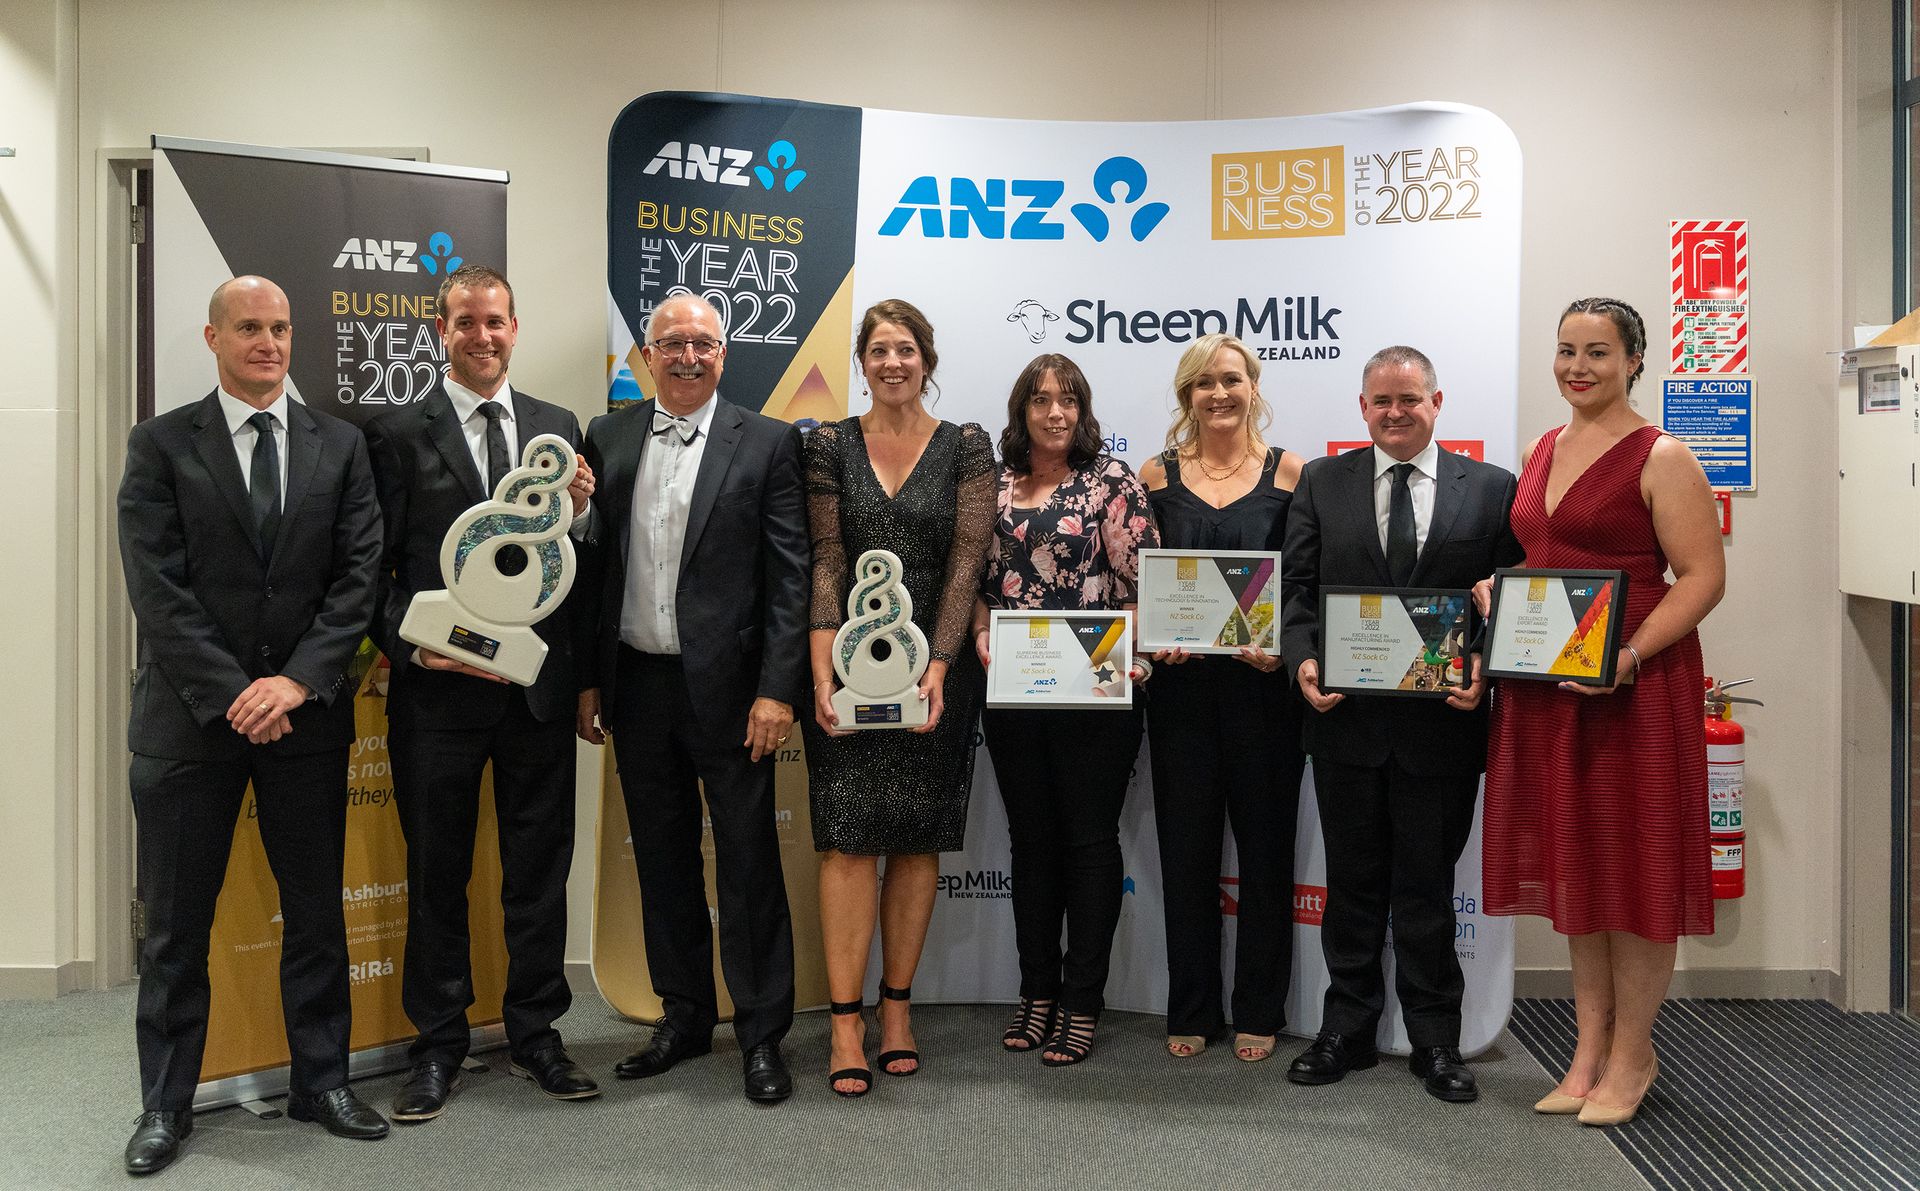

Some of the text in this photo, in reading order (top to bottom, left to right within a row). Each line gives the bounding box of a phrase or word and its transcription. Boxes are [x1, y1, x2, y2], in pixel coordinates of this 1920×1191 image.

[642, 141, 753, 186] ANZ
[1222, 158, 1330, 197] BUSI
[1373, 146, 1480, 184] YEAR
[878, 176, 1064, 240] ANZ
[1354, 154, 1372, 226] OF THE
[1376, 180, 1482, 224] 2022
[637, 201, 804, 245] BUSINESS
[1222, 193, 1334, 232] NESS
[332, 238, 418, 273] ANZ
[640, 237, 662, 292] THE
[666, 239, 800, 294] YEAR
[664, 285, 798, 345] 022
[1234, 296, 1342, 340] Milk
[336, 322, 355, 404] OF THE
[1256, 346, 1341, 361] ZEALAND
[359, 360, 451, 406] 202
[1668, 382, 1746, 392] FIRE ACTION
[1727, 848, 1741, 856] FFP
[965, 871, 1012, 890] Milk
[234, 944, 250, 952] This
[251, 941, 272, 950] event
[353, 923, 384, 932] managed
[386, 920, 395, 928] by
[366, 932, 391, 941] District
